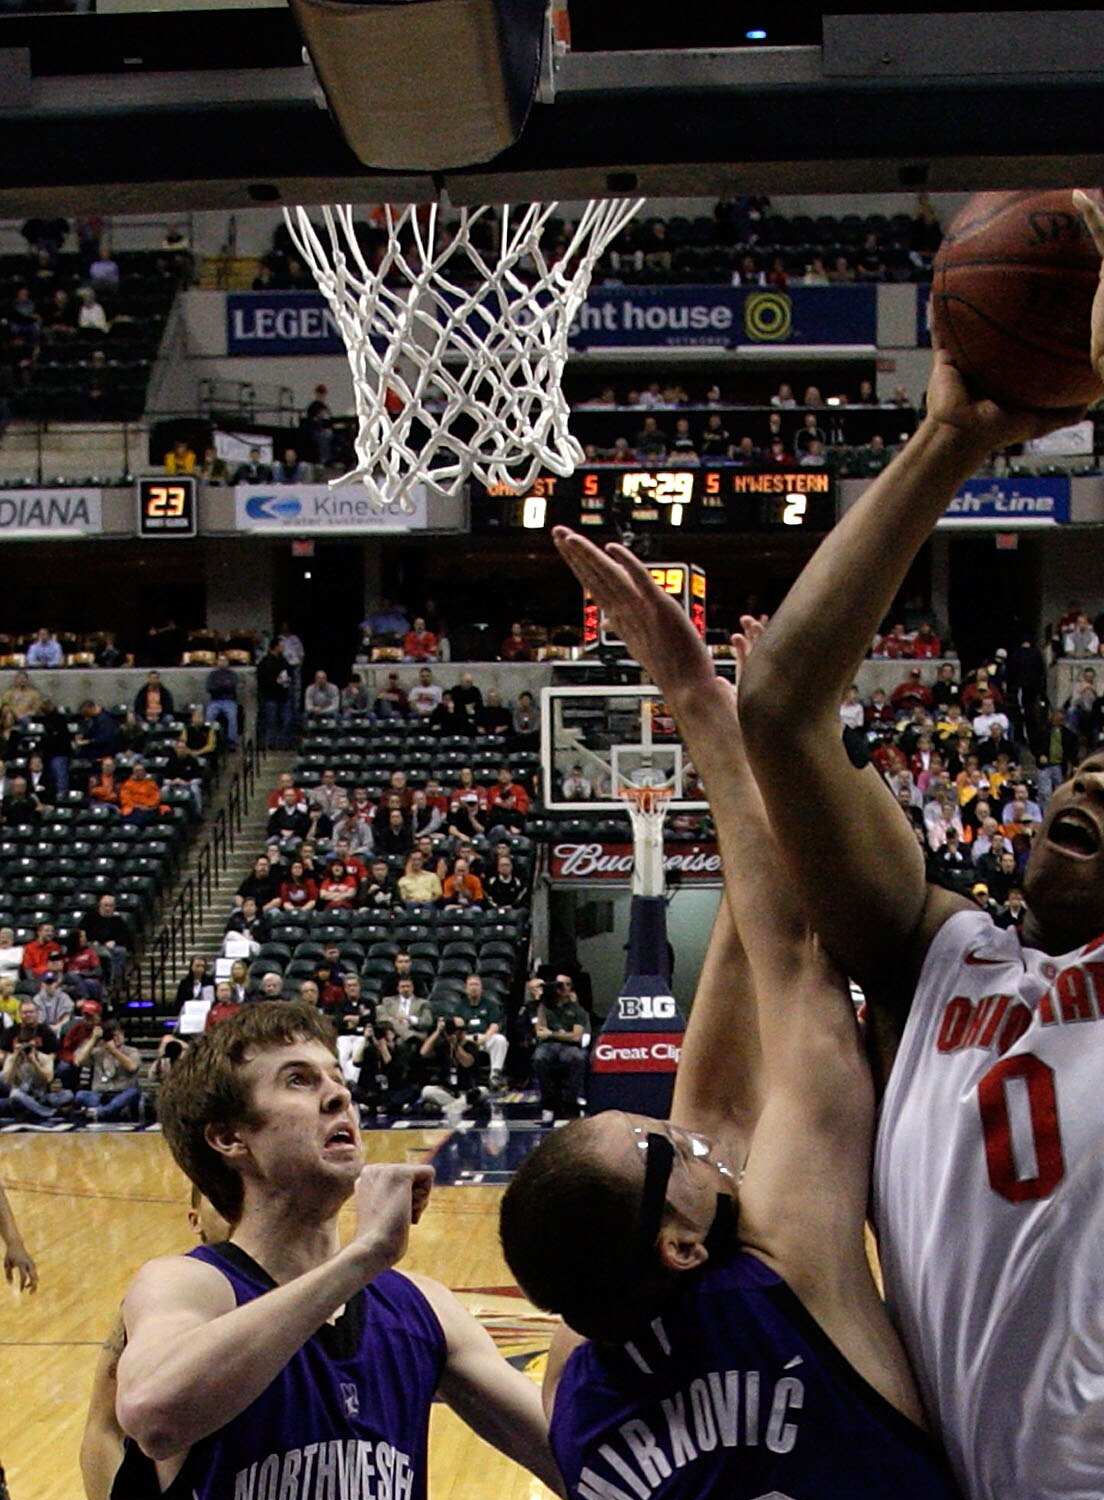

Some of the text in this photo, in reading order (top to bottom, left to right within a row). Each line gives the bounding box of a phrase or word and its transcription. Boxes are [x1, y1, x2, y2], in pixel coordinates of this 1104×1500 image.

[624, 303, 733, 331] house
[533, 477, 557, 496] ST
[583, 475, 598, 495] 5
[706, 474, 719, 493] 5
[735, 475, 829, 493] N'WESTERN
[0, 497, 90, 527] DIANA
[147, 487, 185, 517] 23
[523, 497, 547, 528] 0
[783, 494, 807, 525] 2
[995, 491, 1055, 511] Line
[619, 995, 676, 1019] BIG
[596, 1044, 649, 1060] Great
[977, 1051, 1066, 1204] 0
